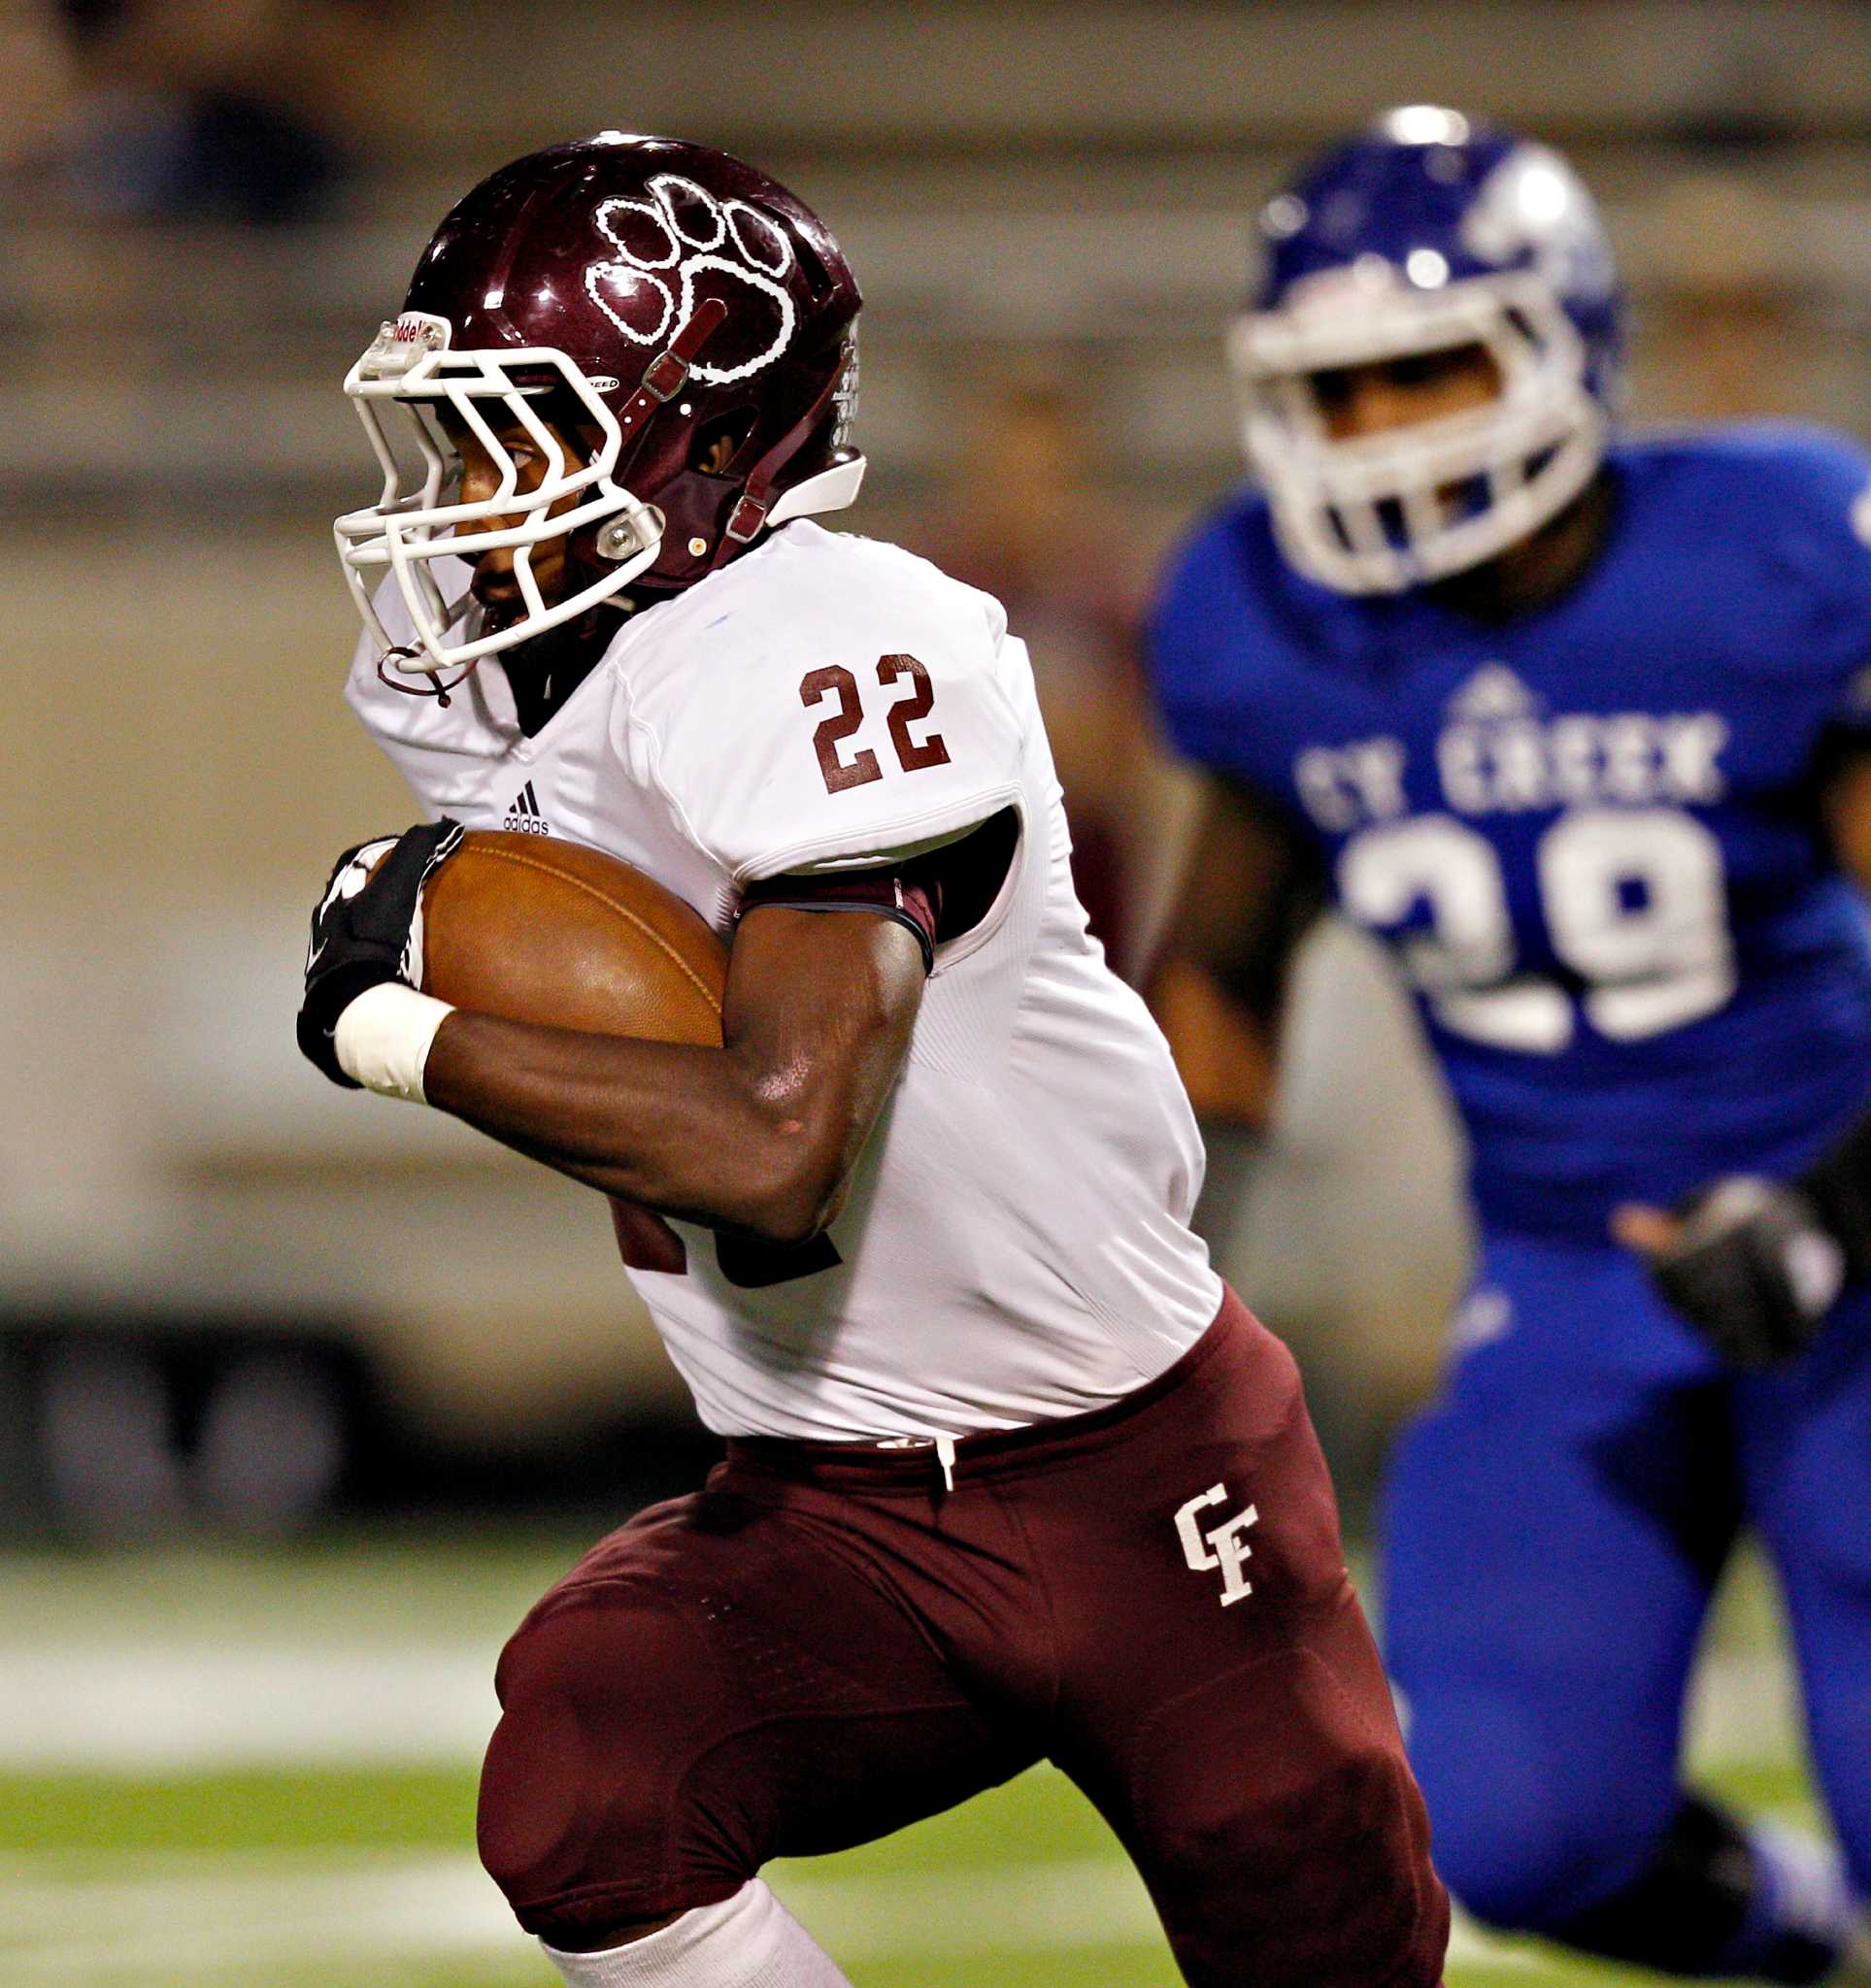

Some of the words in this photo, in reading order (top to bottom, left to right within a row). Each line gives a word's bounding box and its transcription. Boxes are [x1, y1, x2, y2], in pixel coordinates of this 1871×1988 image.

[799, 653, 952, 794] 22
[1436, 710, 1729, 812] CREEK
[504, 813, 549, 835] adidas
[1337, 812, 1738, 1054] 29
